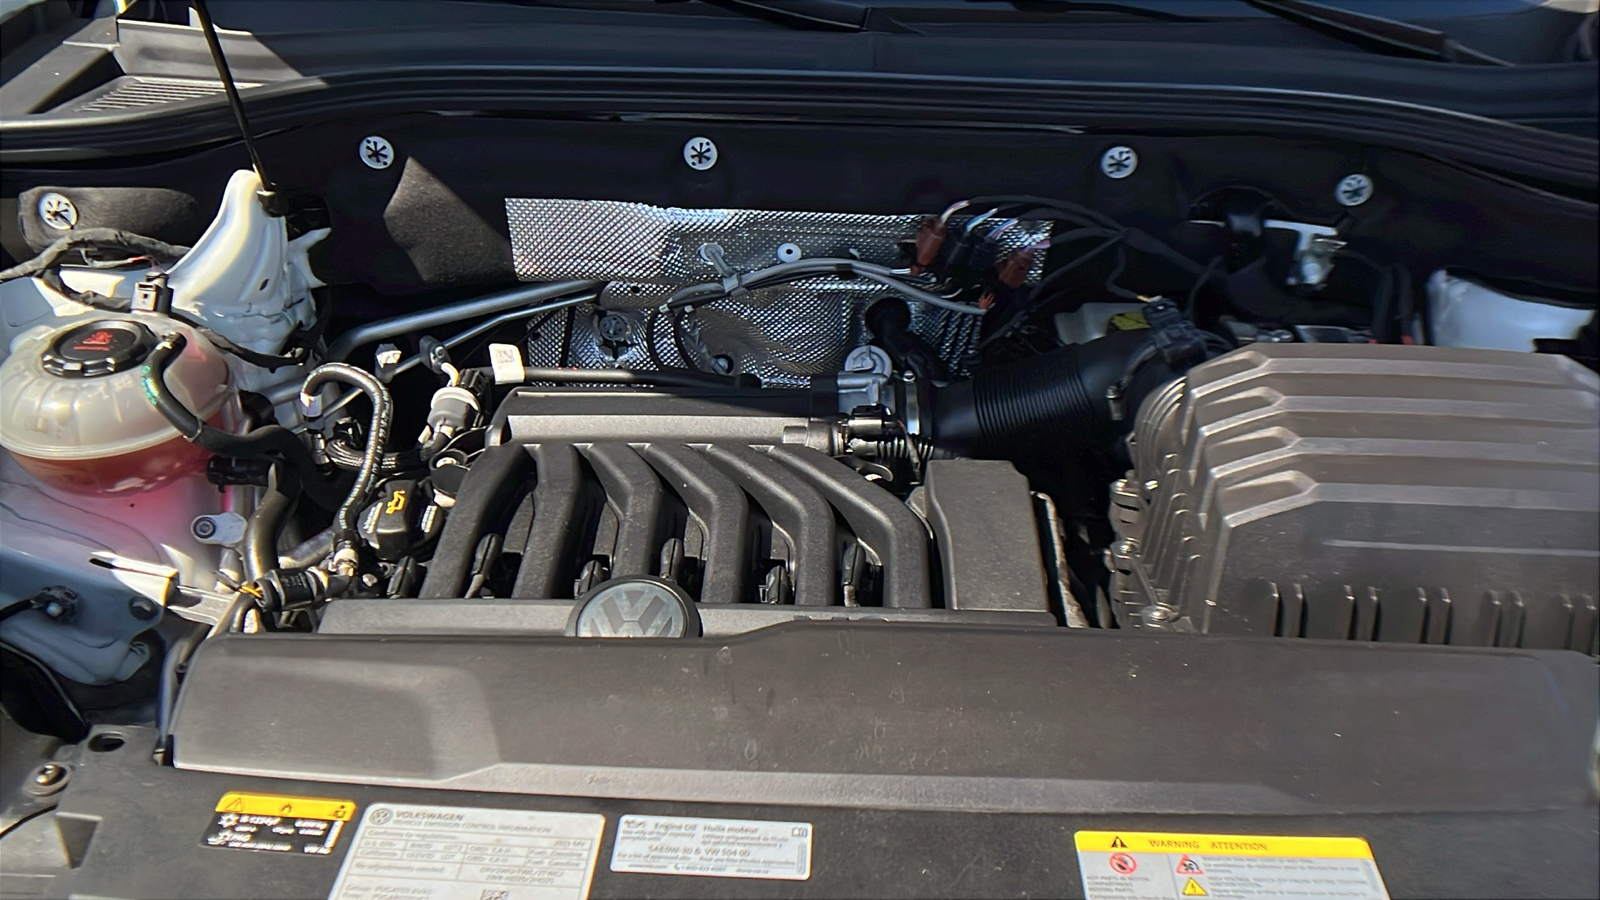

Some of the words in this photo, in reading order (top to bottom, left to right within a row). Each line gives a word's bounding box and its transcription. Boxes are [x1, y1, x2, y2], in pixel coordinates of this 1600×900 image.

[395, 810, 464, 821] VOLKSWAGEN
[497, 825, 551, 833] INFORMATION
[654, 822, 682, 832] Engine
[684, 823, 698, 831] Oil
[727, 826, 759, 834] moteur
[1148, 840, 1200, 849] WARNING
[1211, 841, 1268, 851] ATTENTION
